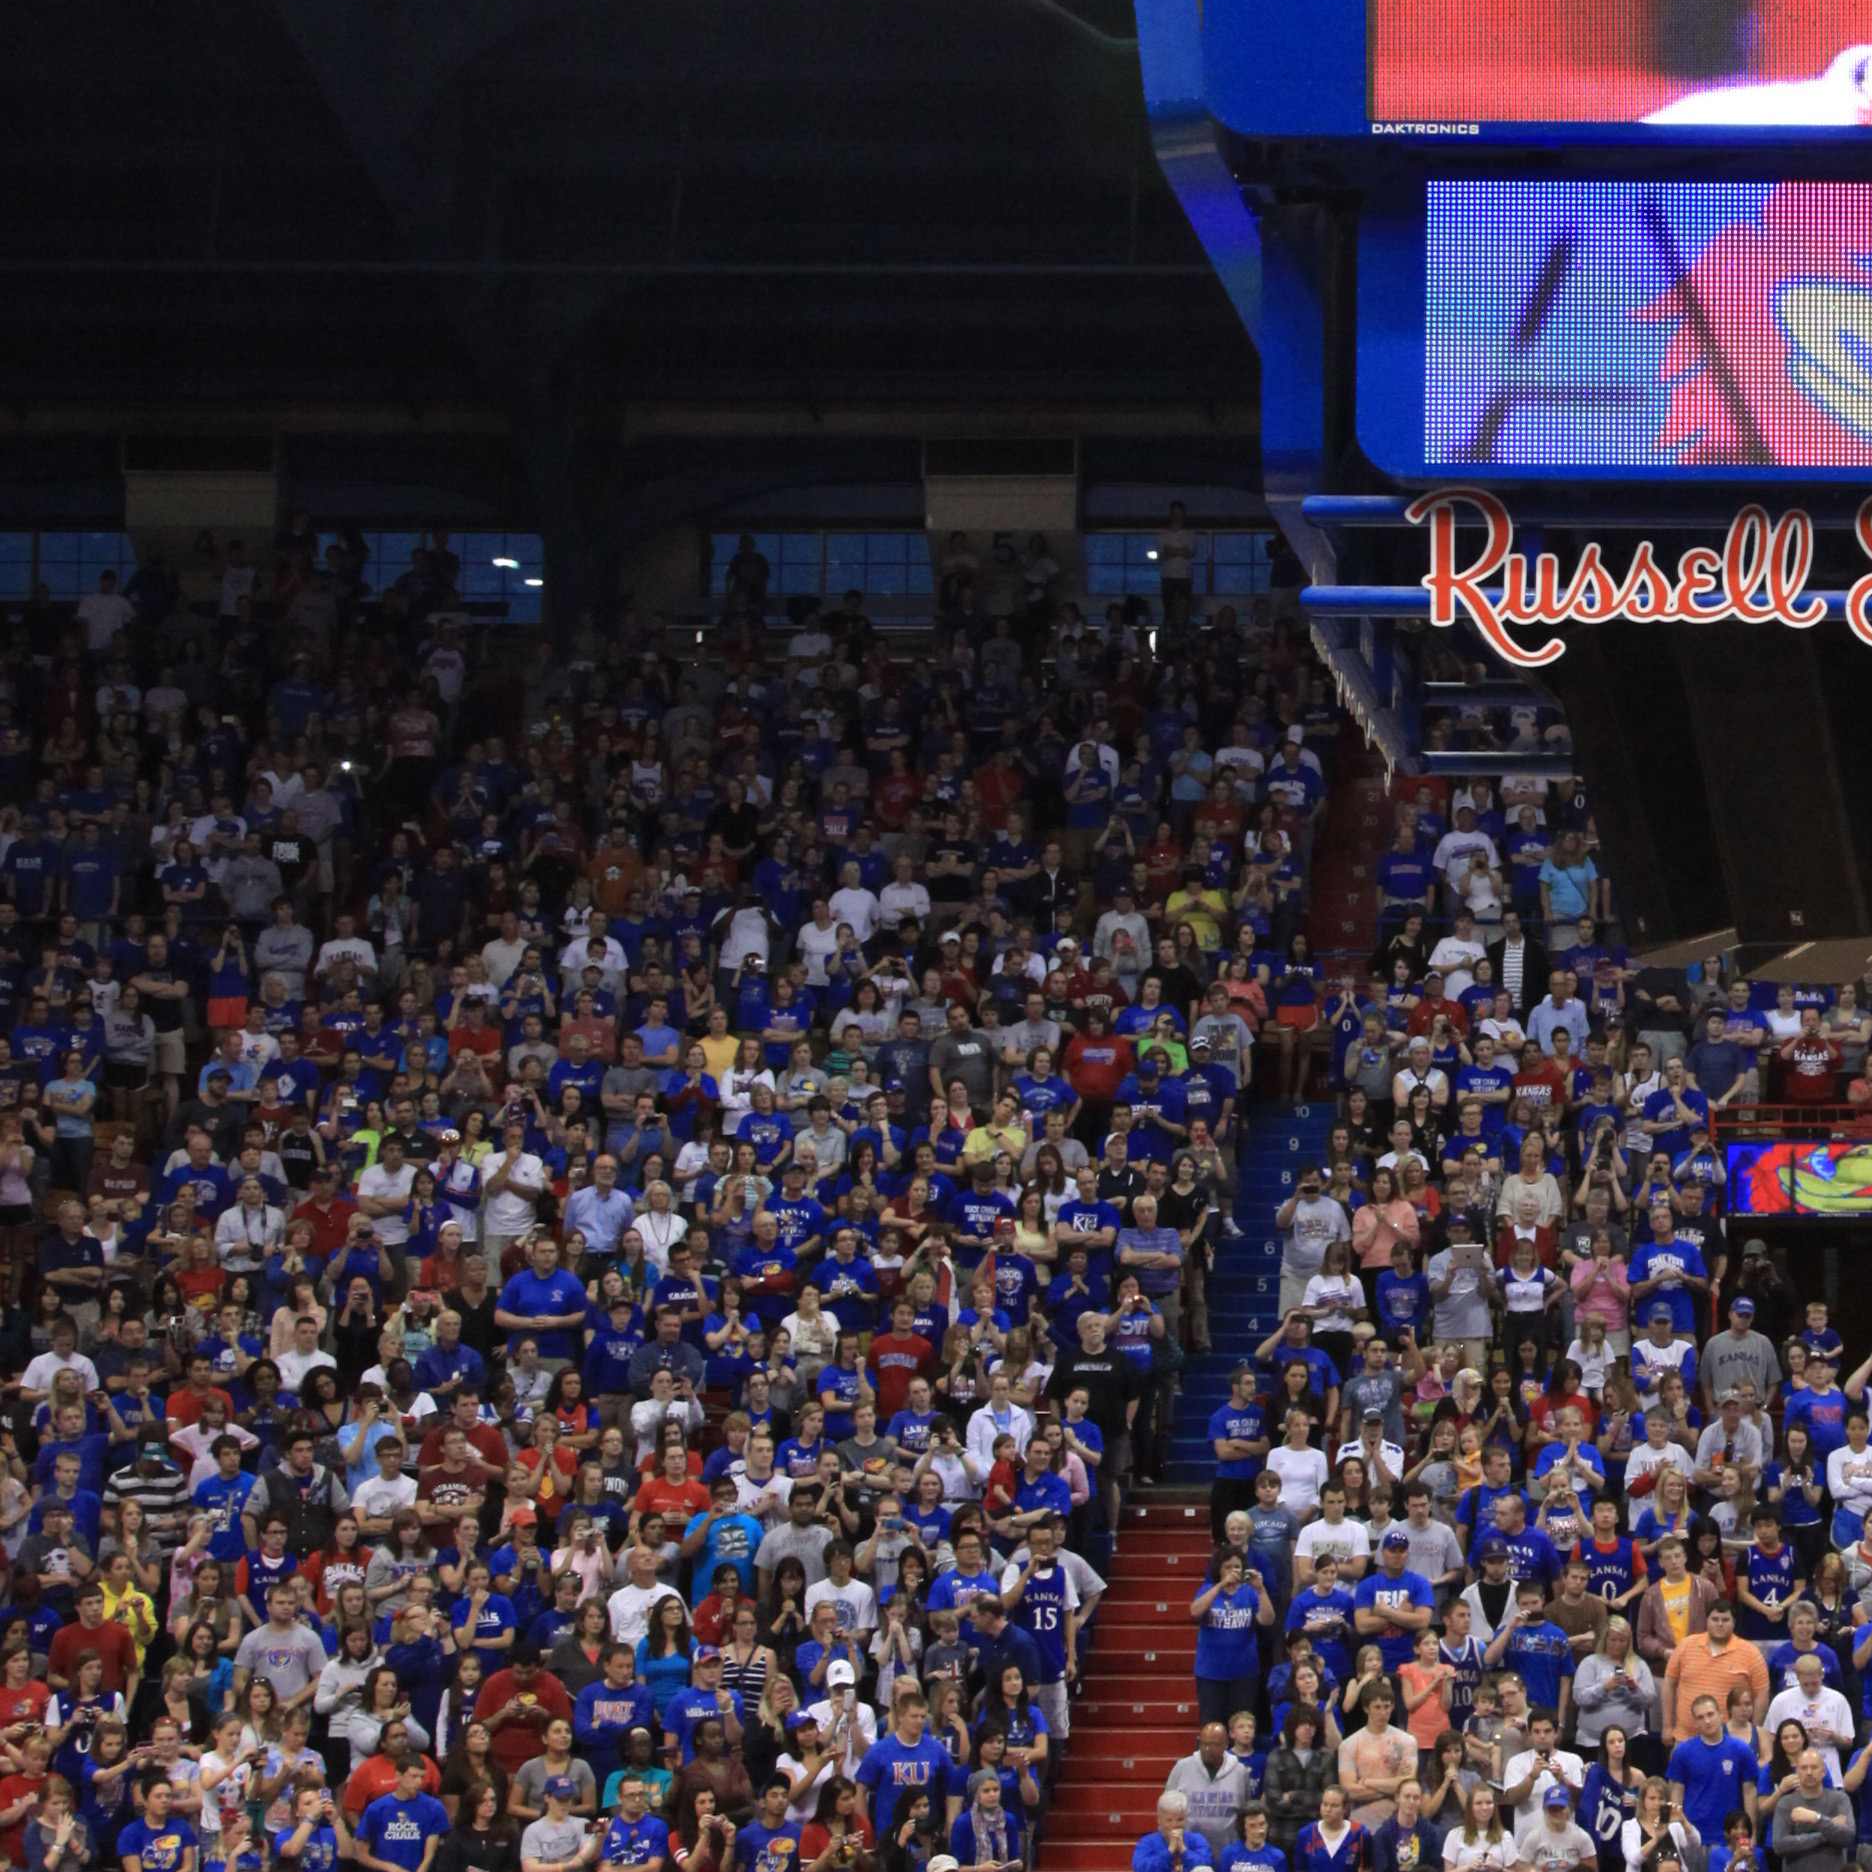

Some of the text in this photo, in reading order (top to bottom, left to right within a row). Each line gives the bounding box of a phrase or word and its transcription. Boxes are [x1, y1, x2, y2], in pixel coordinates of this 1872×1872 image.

[1371, 123, 1480, 135] DAKTRONICS
[1405, 485, 1828, 667] Russell
[1342, 1019, 1351, 1032] 0
[1516, 1086, 1552, 1098] KANSAS
[1295, 1104, 1310, 1118] 10
[1288, 1137, 1300, 1152] 9
[1280, 1170, 1292, 1184] 8
[1263, 1241, 1275, 1255] 6
[1256, 1278, 1267, 1291] 5
[1247, 1317, 1259, 1330] 4
[1718, 1353, 1760, 1367] KANSAS
[1752, 1575, 1790, 1586] KANSAS
[1602, 1580, 1616, 1600] 0
[1763, 1588, 1778, 1604] 4
[1033, 1606, 1057, 1630] 15
[892, 1761, 928, 1786] KU
[388, 1822, 418, 1831] ROCK
[384, 1831, 420, 1841] CHALK
